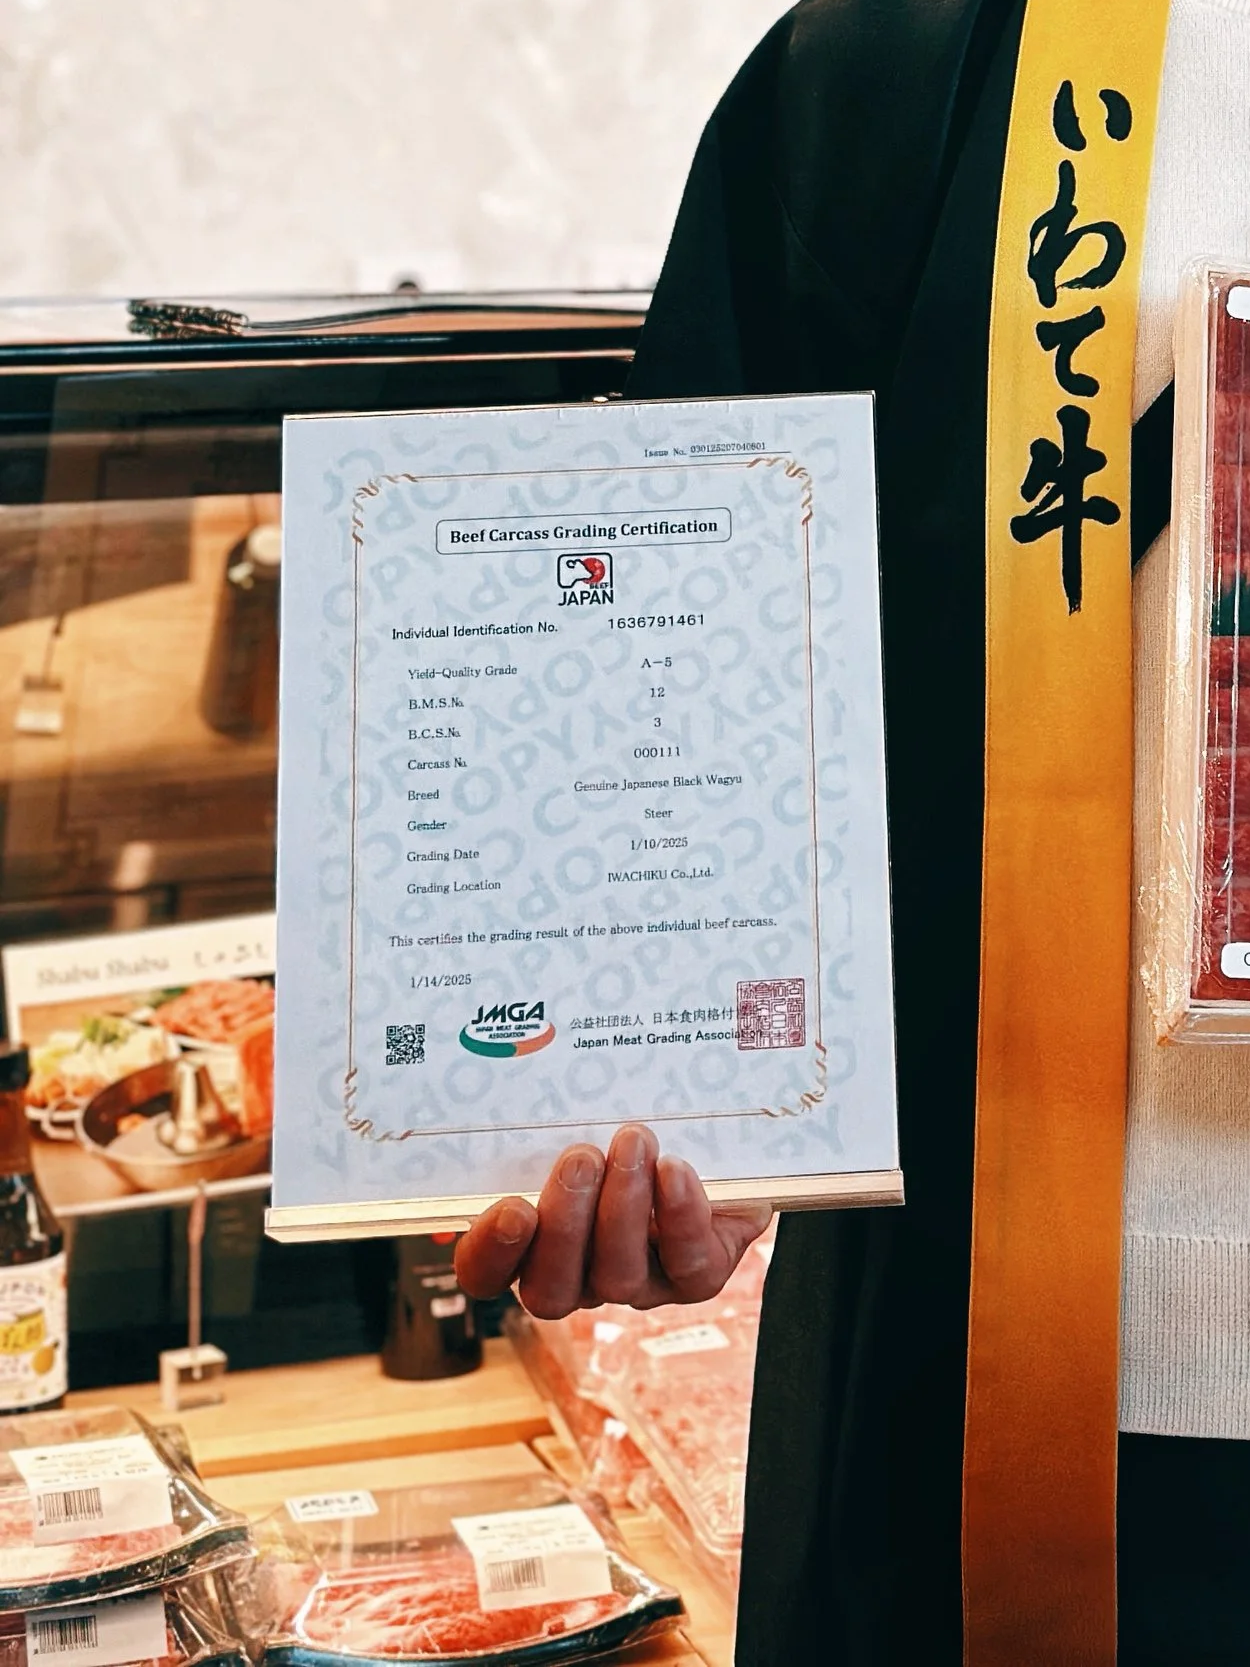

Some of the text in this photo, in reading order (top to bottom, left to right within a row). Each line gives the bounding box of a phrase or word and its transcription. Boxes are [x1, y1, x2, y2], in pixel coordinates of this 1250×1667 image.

[1010, 79, 1132, 615] いわて牛
[645, 449, 668, 457] Issue
[451, 520, 717, 543] Beef Carcass Grading Certification
[558, 589, 614, 606] JAPAN
[608, 614, 703, 629] 1636791461
[393, 622, 557, 640] Individual Identification No.
[408, 664, 517, 679] Yield-Quality Grade
[651, 687, 665, 698] 12
[654, 718, 661, 727] 3
[634, 747, 680, 758] 000111
[408, 760, 450, 770] Carcass
[574, 775, 742, 791] Genuine Japanese Black Wagyu
[408, 789, 439, 800] Breed
[645, 809, 673, 818] Steer
[408, 820, 447, 831] Gender
[632, 837, 688, 850] 1/10/2025
[407, 849, 479, 862] Grading Date
[608, 870, 667, 882] IWACHIKU
[407, 880, 500, 894] Grading Location
[389, 918, 776, 947] This certifies the grading result of the above individual beef carcass.
[412, 974, 471, 988] 1/14/2025
[472, 1001, 544, 1024] JMGA
[570, 1013, 644, 1030] 公益社団法人
[574, 1038, 608, 1049] Japan
[614, 1035, 642, 1046] Meat
[647, 1032, 691, 1044] Grading
